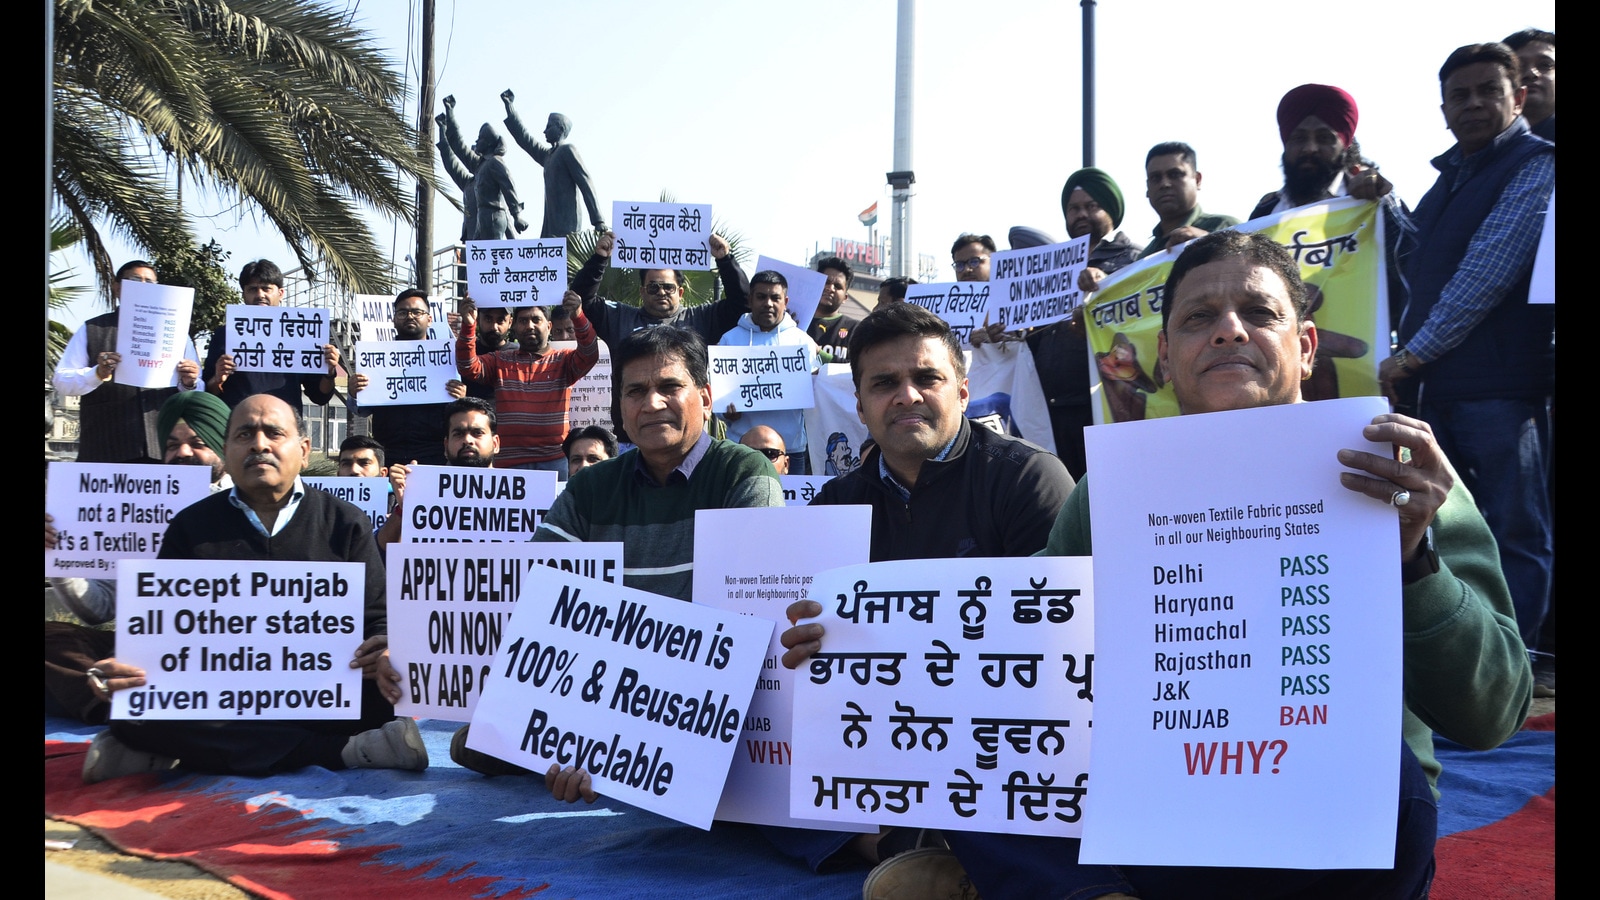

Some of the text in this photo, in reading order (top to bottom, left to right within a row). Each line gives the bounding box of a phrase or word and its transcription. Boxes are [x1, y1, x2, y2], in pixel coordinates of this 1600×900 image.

[623, 206, 701, 238] नॉन वुवन कैरी
[617, 238, 708, 266] बैग को पास करो
[835, 240, 881, 265] HOTEL
[995, 242, 1086, 280] APPLY DELHI MODULE
[531, 285, 539, 302] ਹੈ
[945, 284, 990, 313] विरोधी
[1010, 269, 1073, 302] ON NON-WOVEN
[234, 311, 323, 338] ਵਪਾਰ ਵਿਰੋਧੀ
[362, 302, 384, 322] AAM
[999, 305, 1011, 326] BY
[1013, 303, 1029, 325] AAP
[138, 359, 163, 368] WHY?
[232, 341, 324, 368] ਨੀਤੀ ਬੰਦ ਕਰੋ
[360, 341, 452, 368] आम आदमी पार्टी
[713, 348, 807, 375] आम आदमी पार्टी
[386, 369, 427, 400] मुर्दाबाद
[740, 376, 783, 408] मुर्दाबाद
[79, 472, 180, 495] Non-Woven is
[359, 483, 371, 501] is
[439, 474, 526, 500] PUNJAB
[78, 503, 173, 524] not a Plastic
[412, 505, 549, 532] GOVENMENT
[1148, 499, 1324, 527] Non-woven Textile Fabric passed
[53, 530, 75, 551] t's
[80, 536, 89, 551] a
[94, 531, 147, 553] Textile
[1155, 522, 1320, 546] in all our Neighbouring States
[54, 558, 95, 570] Approved
[98, 559, 109, 571] By
[1153, 554, 1329, 585] Delhi PASS
[137, 572, 349, 603] Except Punjab
[401, 558, 459, 601] APPLY
[464, 558, 520, 602] DELHI
[725, 575, 758, 585] Non-woven
[759, 574, 779, 585] Textile
[781, 574, 800, 584] Fabric
[727, 590, 734, 599] in
[735, 589, 744, 599] all
[745, 591, 755, 599] our
[757, 588, 799, 601] Neighbouring
[836, 575, 1081, 640] ਪੰਜਾਬ ਨੂੰ ਛੱਡ
[1154, 584, 1330, 617] Haryana PASS
[128, 609, 355, 635] all Other states
[428, 610, 454, 654] ON
[549, 585, 734, 670] Non-Woven is
[1154, 614, 1331, 643] Himachal PASS
[161, 647, 332, 672] of India has
[809, 652, 907, 685] ਭਾਰਤ
[924, 640, 960, 687] ਦੇ
[978, 653, 1044, 688] ਹਰ
[1154, 644, 1331, 675] Rajasthan PASS
[408, 662, 432, 705] BY
[438, 664, 473, 708] AAP
[504, 637, 579, 697] 100%
[581, 660, 607, 705] &
[609, 667, 740, 743] Reusable
[1152, 674, 1330, 701] J&K PASS
[128, 683, 351, 717] given approvel.
[840, 701, 872, 749] ਨੇ
[888, 700, 953, 752] ਨੋਨ
[1152, 704, 1328, 730] PUNJAB BAN
[520, 708, 674, 797] Recyclable
[1183, 739, 1288, 776] WHY?
[812, 775, 930, 814] ਮਾਨਤਾ
[947, 768, 983, 818] ਦੇ
